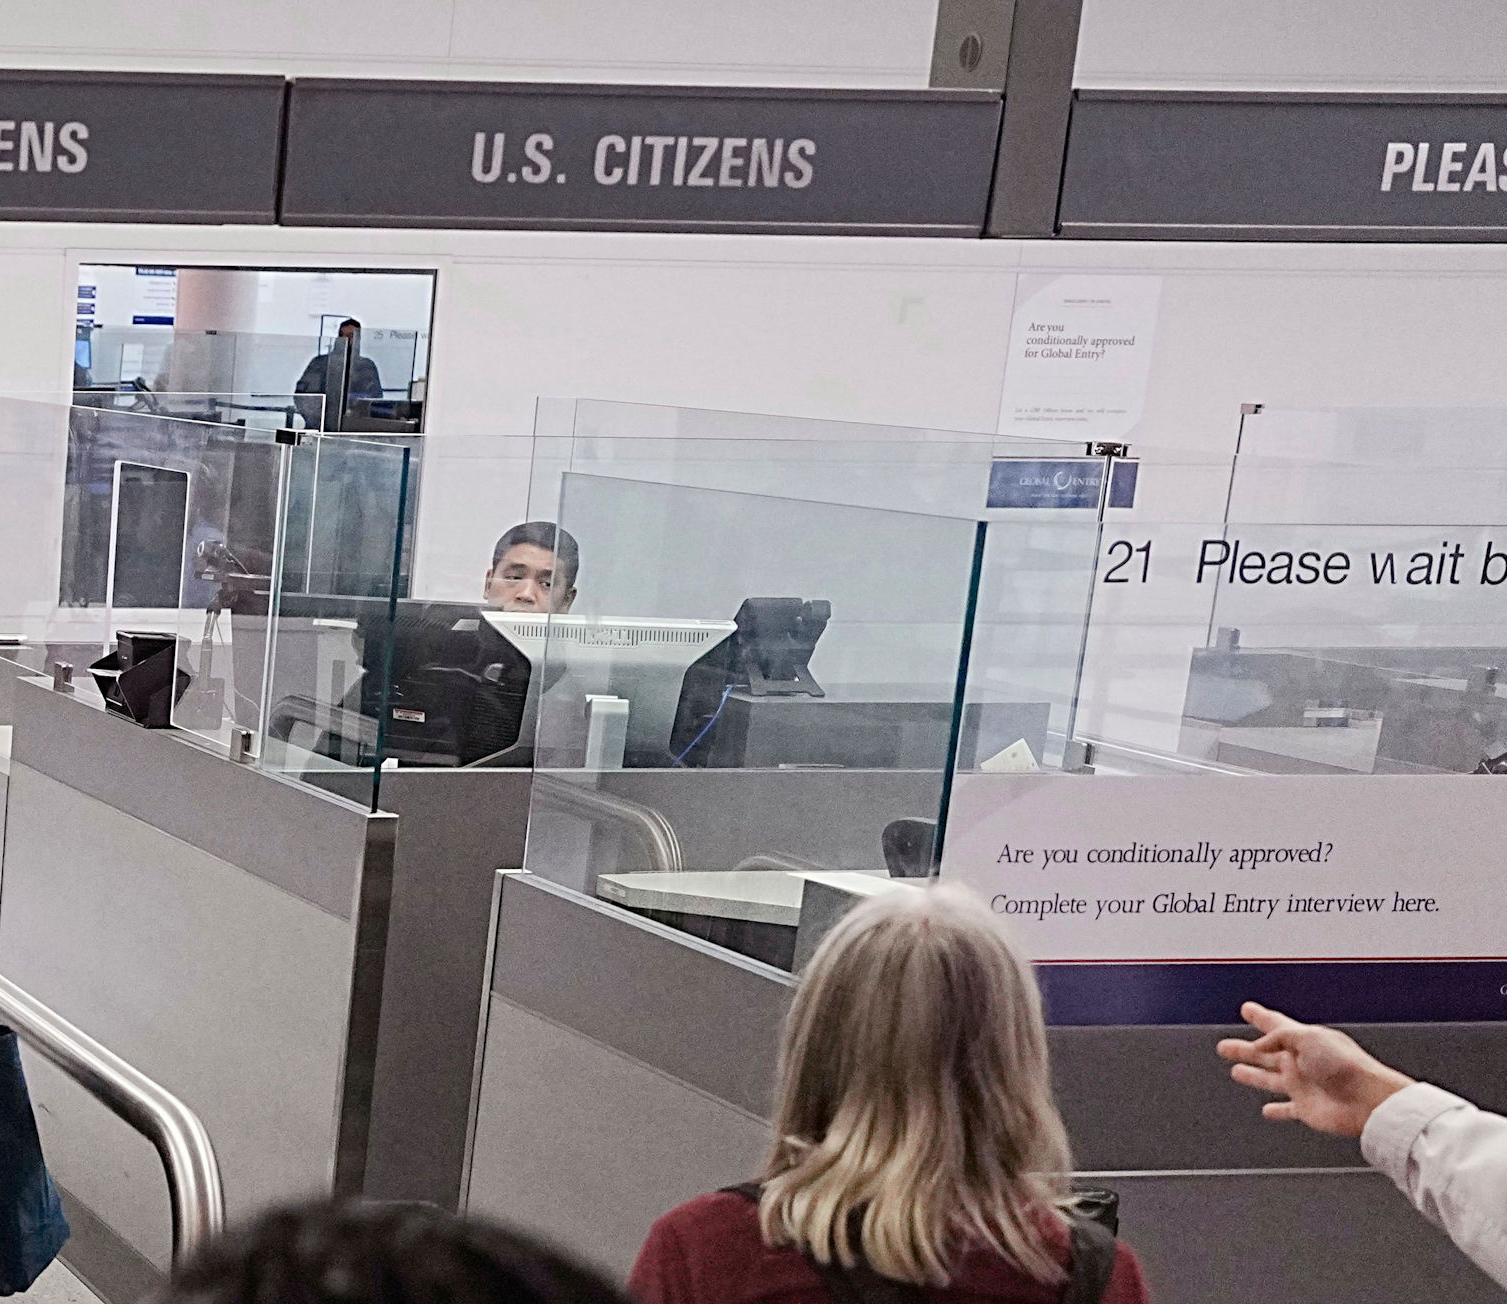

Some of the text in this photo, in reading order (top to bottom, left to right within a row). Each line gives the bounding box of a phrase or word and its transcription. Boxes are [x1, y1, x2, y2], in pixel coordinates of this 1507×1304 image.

[471, 132, 817, 189] U.S. CITIZENS
[1380, 142, 1507, 192] PLEA
[1026, 335, 1136, 349] conditionally approved
[1028, 322, 1065, 336] Are you
[1024, 348, 1106, 361] for Global Entry?
[1103, 540, 1153, 584] 21
[1196, 539, 1351, 585] Please
[997, 842, 1334, 870] Are you conditionally approved?
[990, 892, 1440, 920] Complete your Global Entry interview here.
